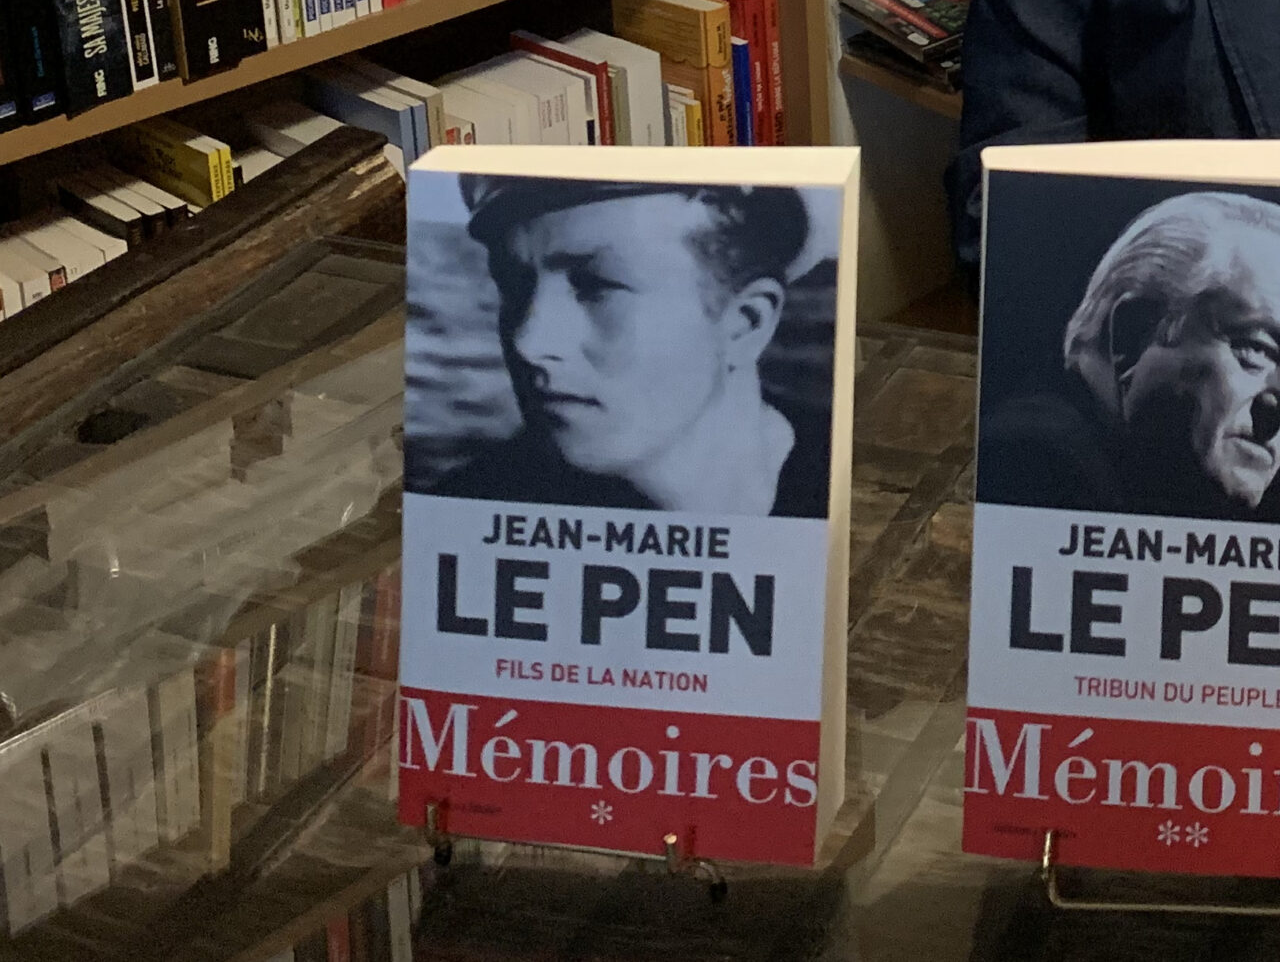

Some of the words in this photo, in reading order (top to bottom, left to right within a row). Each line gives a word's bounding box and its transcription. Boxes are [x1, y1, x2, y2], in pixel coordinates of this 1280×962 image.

[82, 35, 107, 58] SA
[482, 513, 730, 559] JEAN-MARIE
[437, 552, 550, 641] LE
[580, 564, 775, 656] PEN
[1009, 566, 1129, 657] LE
[496, 659, 543, 681] FILS
[551, 664, 580, 684] DE
[587, 666, 615, 686] LA
[622, 669, 708, 692] NATION
[1074, 676, 1156, 701] TRIBUN
[1163, 682, 1193, 703] DU
[400, 697, 818, 807] Mémoires
